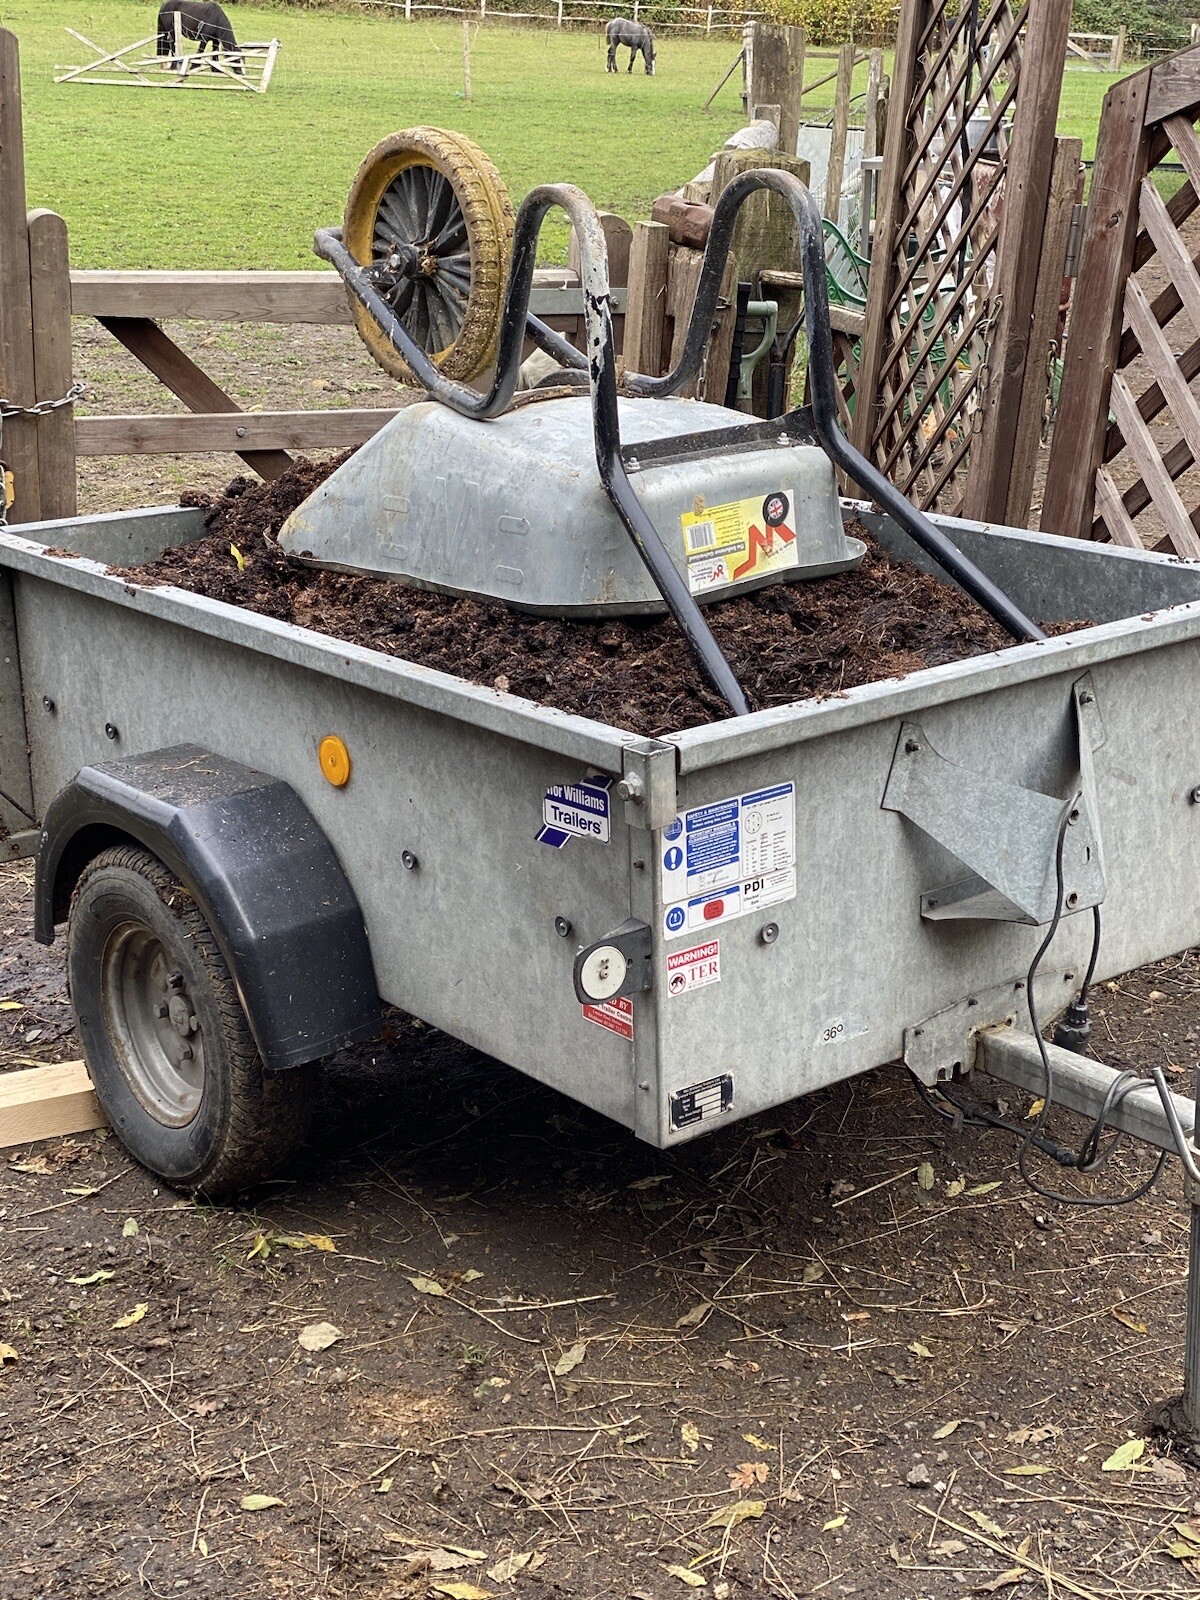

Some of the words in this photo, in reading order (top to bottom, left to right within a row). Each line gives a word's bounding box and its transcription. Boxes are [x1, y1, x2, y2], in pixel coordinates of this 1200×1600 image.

[564, 785, 605, 812] Williams
[551, 805, 601, 835] Trailers
[744, 878, 765, 895] PDI
[668, 943, 718, 968] WARNING!
[688, 961, 718, 981] TER
